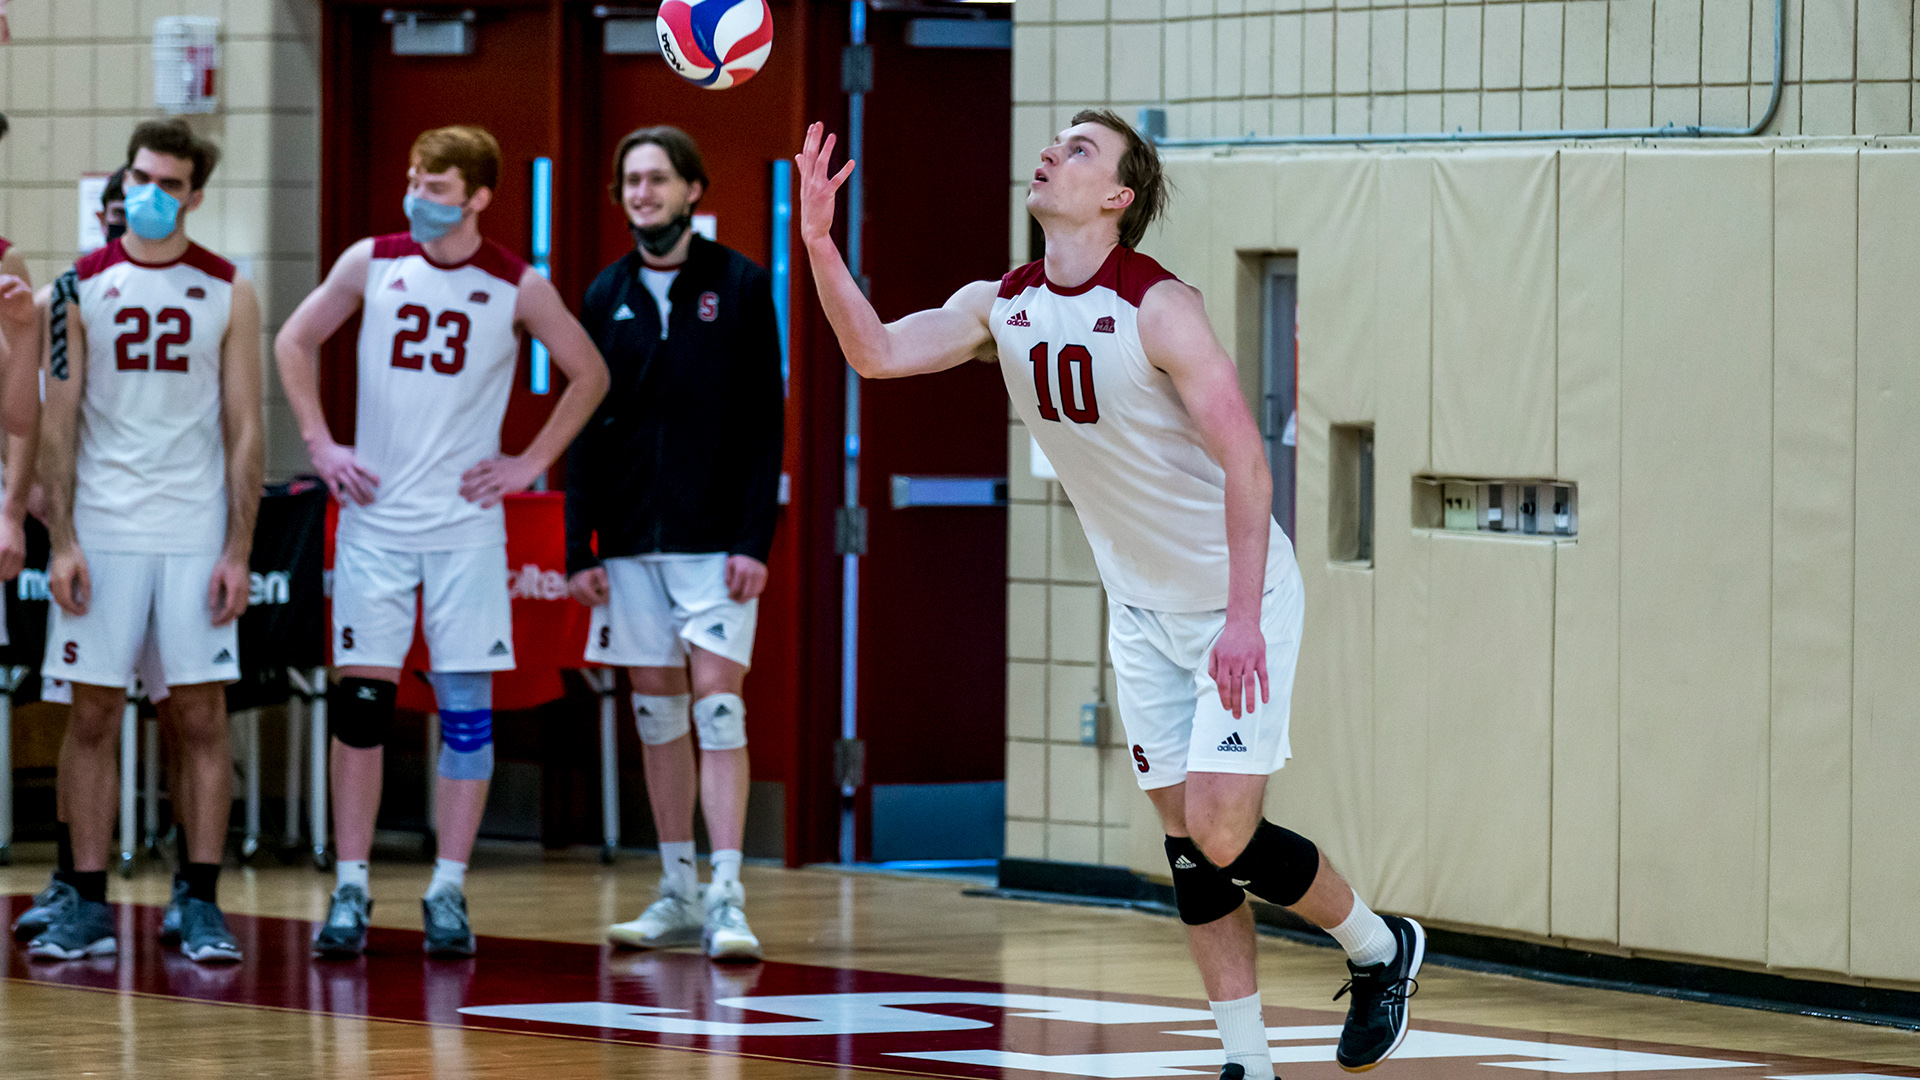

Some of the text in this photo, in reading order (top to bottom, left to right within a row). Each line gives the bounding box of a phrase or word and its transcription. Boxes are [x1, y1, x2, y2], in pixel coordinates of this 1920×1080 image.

[661, 32, 685, 71] NCAA
[698, 291, 720, 322] S
[1006, 319, 1031, 328] adidas
[1094, 323, 1115, 332] MAC
[114, 306, 191, 373] 22
[391, 303, 471, 376] 23
[1029, 341, 1100, 424] 10
[341, 625, 355, 650] S
[600, 625, 610, 649] S
[63, 641, 79, 665] S
[1132, 744, 1150, 773] S
[1217, 743, 1247, 753] adidas
